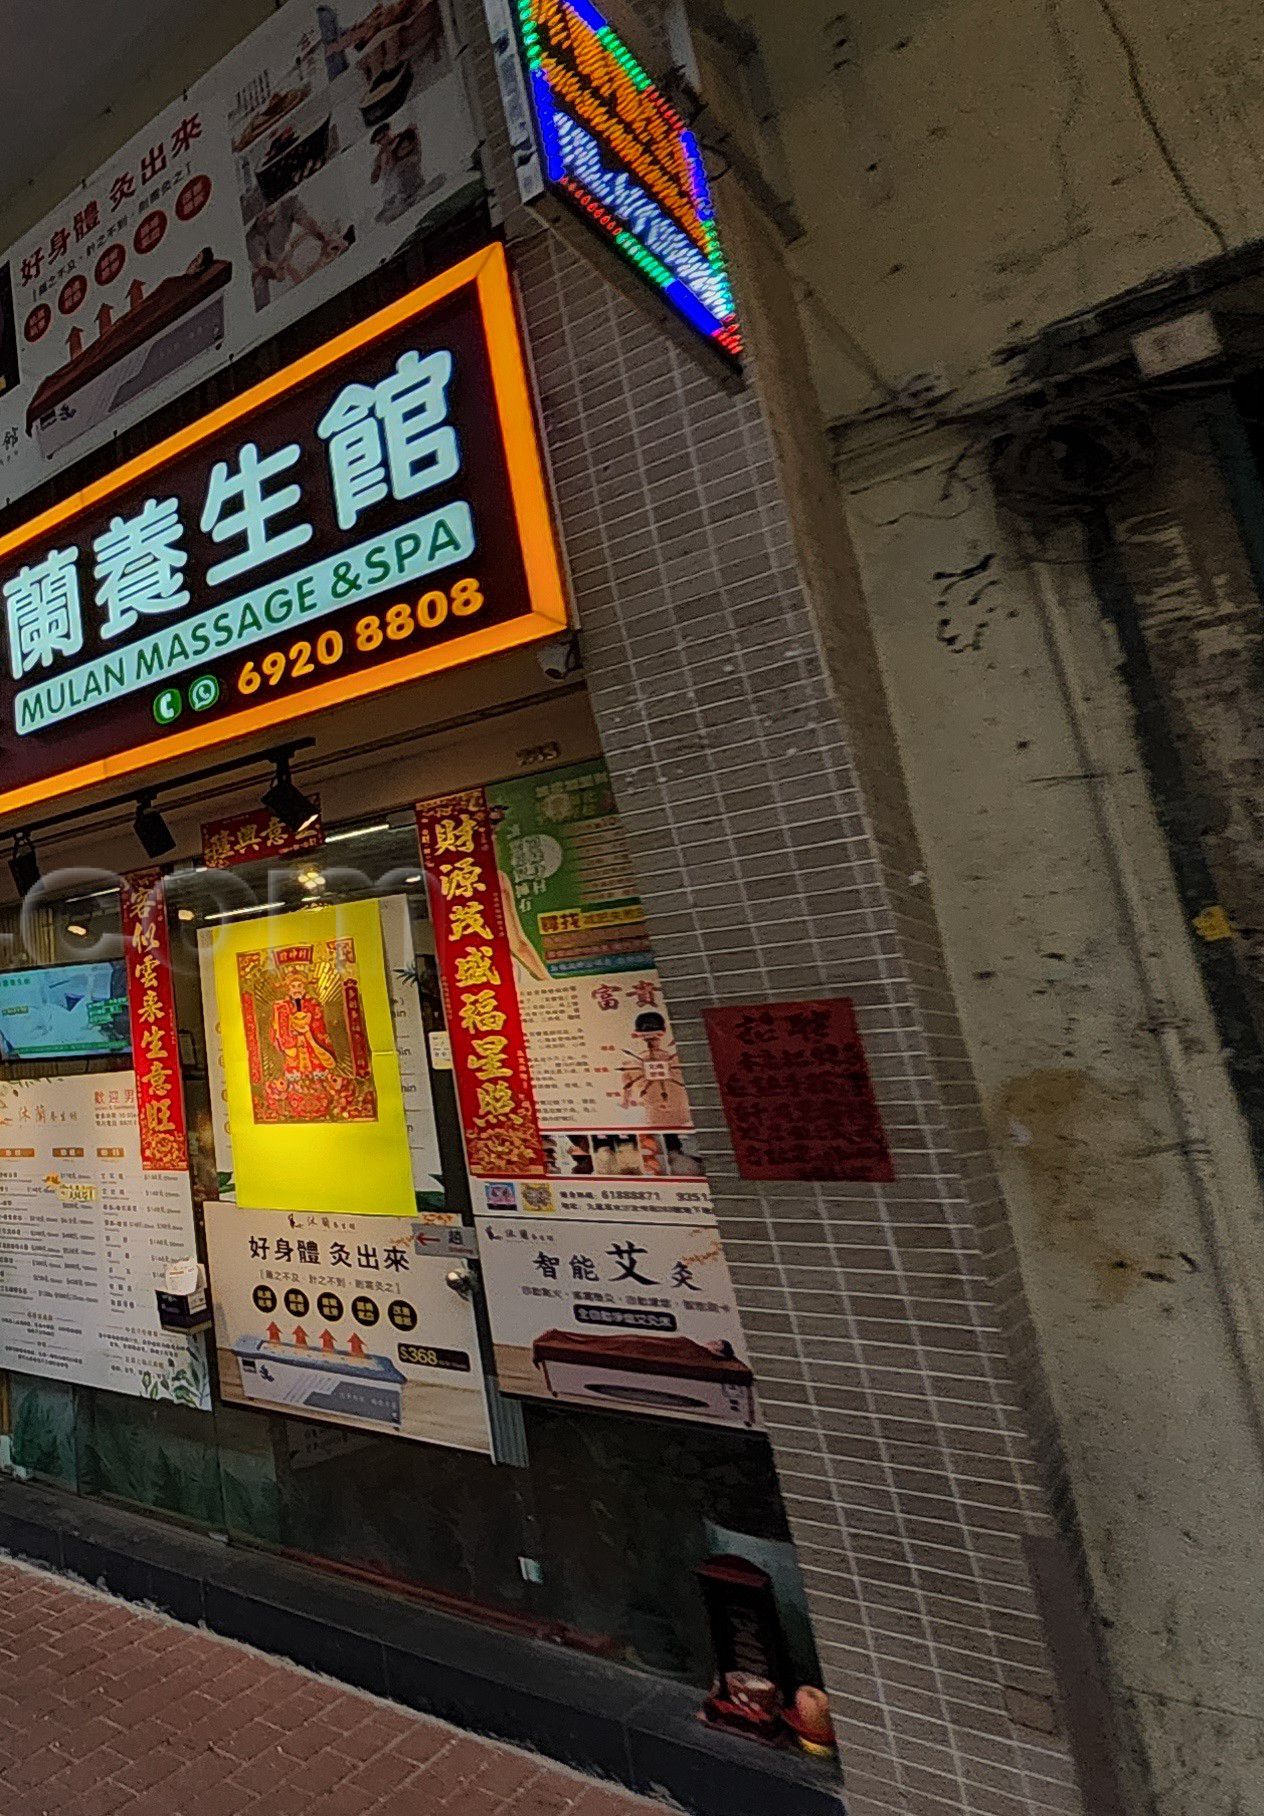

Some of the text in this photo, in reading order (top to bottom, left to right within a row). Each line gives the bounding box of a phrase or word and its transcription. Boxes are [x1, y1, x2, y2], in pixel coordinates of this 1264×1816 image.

[21, 655, 126, 727] MULAN
[136, 588, 318, 682] MASSAGE
[237, 577, 485, 695] 6920 8808
[433, 815, 528, 1128] 財源茂盛福星照
[248, 1235, 411, 1273] 好身體 灸出來
[532, 1240, 704, 1292] 智能艾灸
[399, 1345, 438, 1366] $368
